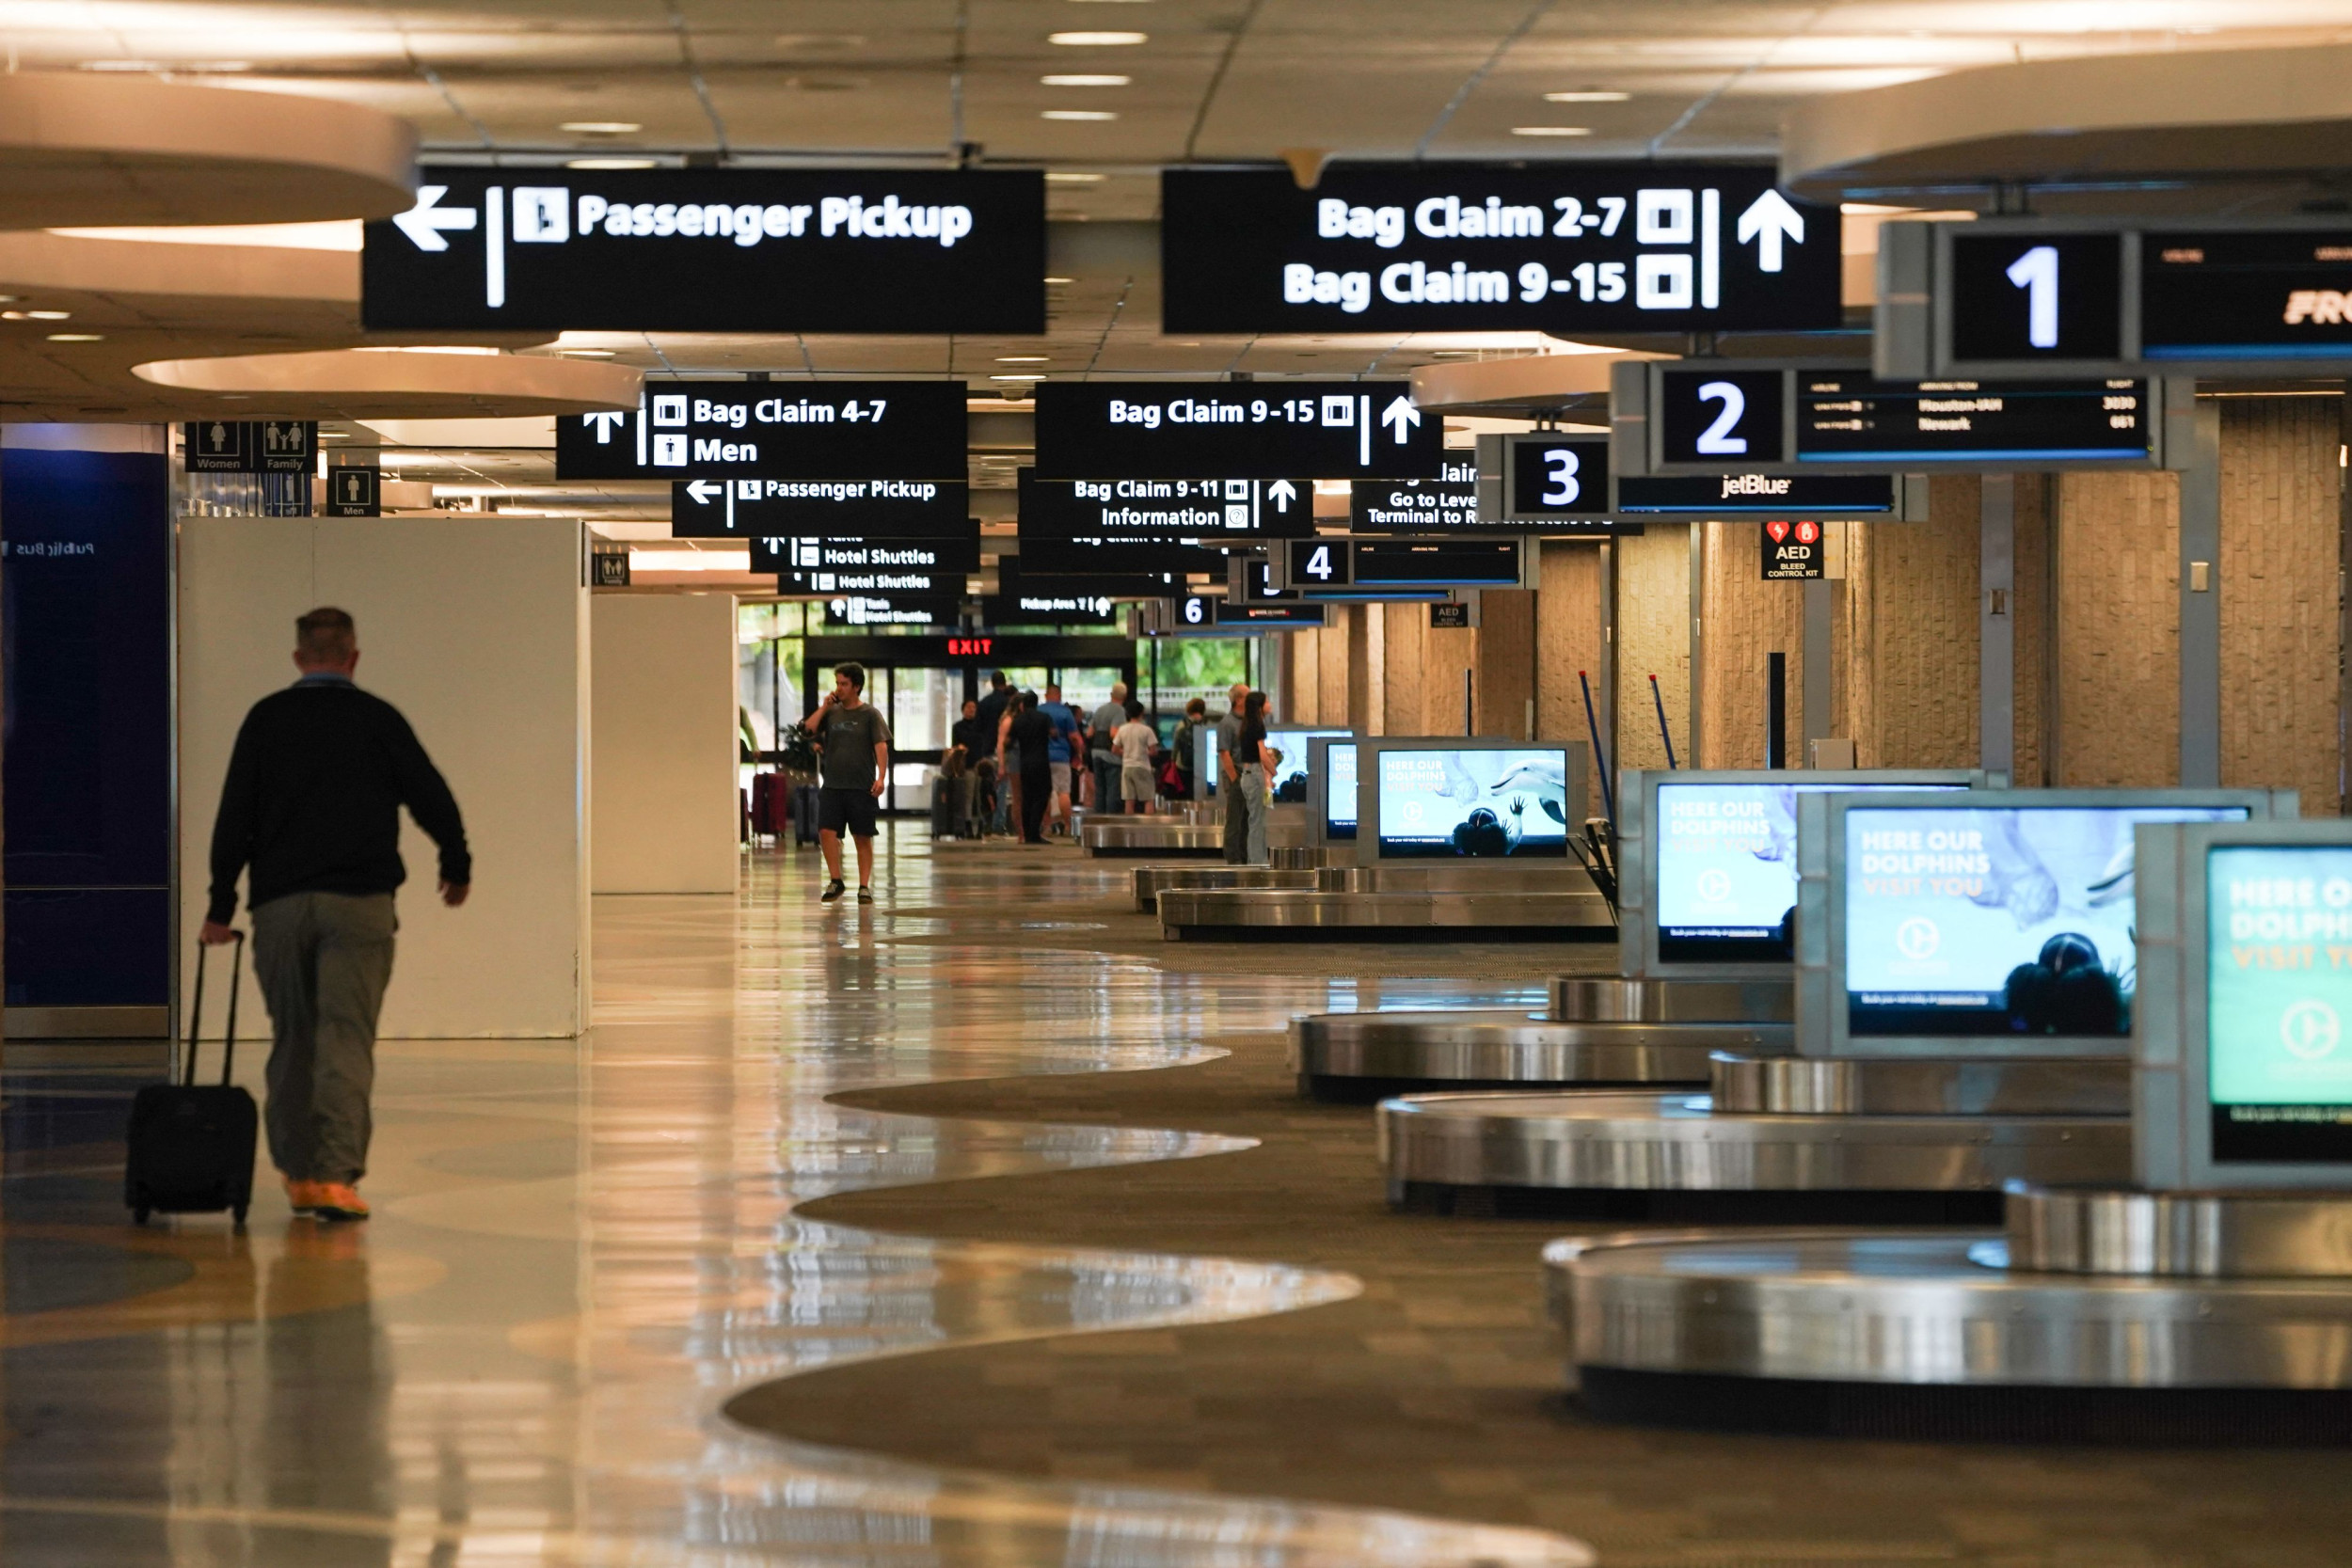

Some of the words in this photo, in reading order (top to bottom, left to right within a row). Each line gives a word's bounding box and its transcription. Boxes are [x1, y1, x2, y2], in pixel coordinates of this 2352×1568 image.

[578, 195, 813, 246] Passenger
[820, 195, 972, 247] Pickup
[1318, 197, 1406, 248] Bag
[1414, 196, 1544, 238] Claim
[1552, 197, 1627, 237] 2-7
[1283, 263, 1371, 313] Bag
[1380, 261, 1510, 304] Claim
[1518, 262, 1627, 303] 9-15
[2006, 246, 2058, 348] 1
[2283, 290, 2352, 325] FR
[694, 399, 747, 428] Bag
[755, 399, 835, 423] Claim
[841, 400, 887, 423] 4-7
[1110, 399, 1162, 429] Bag
[1168, 399, 1244, 423] Claim
[1251, 400, 1315, 423] 9-15
[1695, 381, 1748, 454] 2
[694, 439, 757, 463] Men
[197, 459, 241, 468] Women
[267, 459, 304, 471] Family
[1441, 462, 1479, 483] lai
[1542, 449, 1581, 506] 3
[1721, 474, 1790, 499] jetBlue
[766, 480, 866, 502] Passenger
[872, 480, 936, 500] Pickup
[1075, 480, 1112, 501] Bag
[1117, 480, 1172, 498] Claim
[1177, 481, 1218, 498] 9-11
[1391, 490, 1414, 507] Go
[1417, 491, 1436, 507] to
[1440, 490, 1478, 507] Leve
[343, 506, 364, 515] Men
[1102, 507, 1220, 526] Information
[1368, 509, 1439, 524] Terminal
[1443, 511, 1461, 524] to
[825, 549, 867, 564] Hotel
[871, 548, 935, 564] Shuttles
[1775, 546, 1811, 560] AED
[1306, 546, 1332, 580] 4
[839, 575, 874, 589] Hotel
[877, 574, 930, 589] Shuttles
[1184, 598, 1203, 624] 6
[1438, 608, 1459, 616] AED
[948, 638, 993, 656] EXIT
[1335, 752, 1356, 762] HER
[1387, 761, 1414, 770] HERE
[1417, 761, 1442, 770] OUR
[1387, 771, 1446, 782] DOLPHINS
[1419, 783, 1442, 792] YOU
[1671, 801, 1717, 817] HERE
[1722, 801, 1764, 817] OUR
[1671, 820, 1771, 835] DOLPHINS
[1862, 832, 1922, 850] HERE
[1928, 832, 1983, 850] OUR
[1862, 854, 1991, 874] DOLPHINS
[1863, 878, 1921, 896] VISIT
[1929, 878, 1983, 897] YOU
[2230, 878, 2314, 908] HERE
[2231, 945, 2314, 970] VISIT
[2326, 945, 2352, 970] Y
